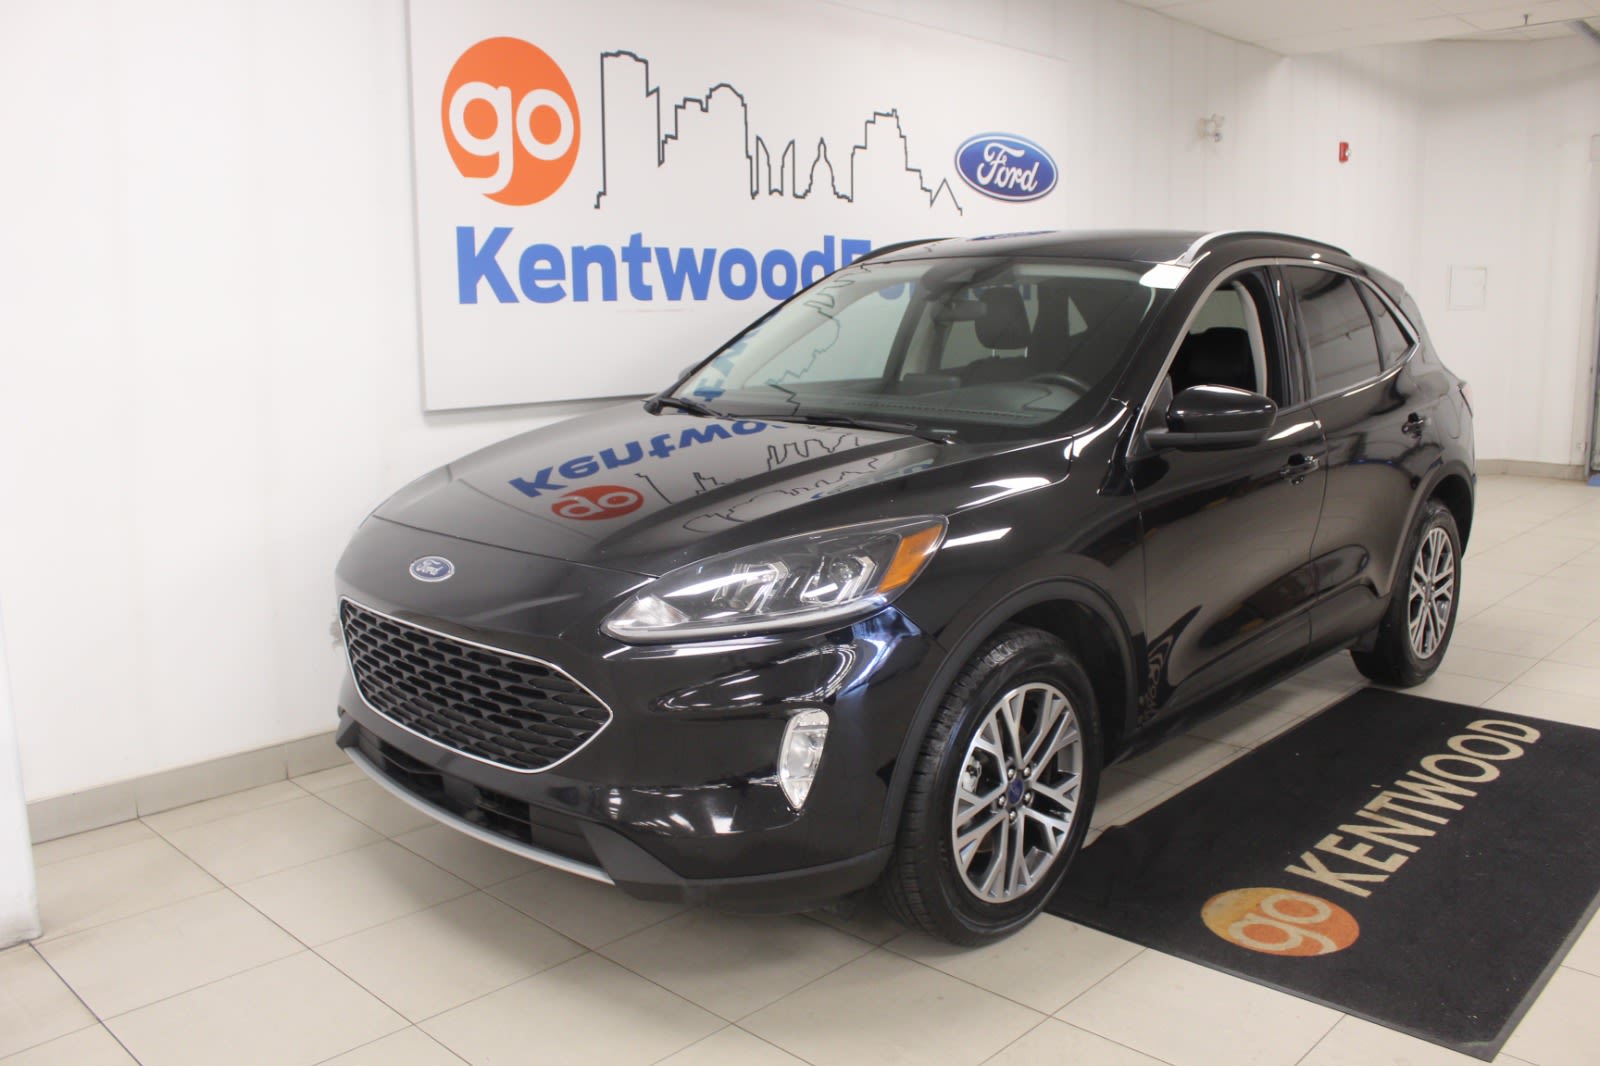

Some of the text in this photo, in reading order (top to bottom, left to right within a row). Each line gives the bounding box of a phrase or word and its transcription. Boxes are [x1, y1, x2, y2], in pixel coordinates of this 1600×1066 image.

[448, 80, 575, 195] go
[976, 142, 1040, 193] Ford
[415, 559, 445, 576] Ford
[1227, 718, 1542, 956] go KENTWOOD
